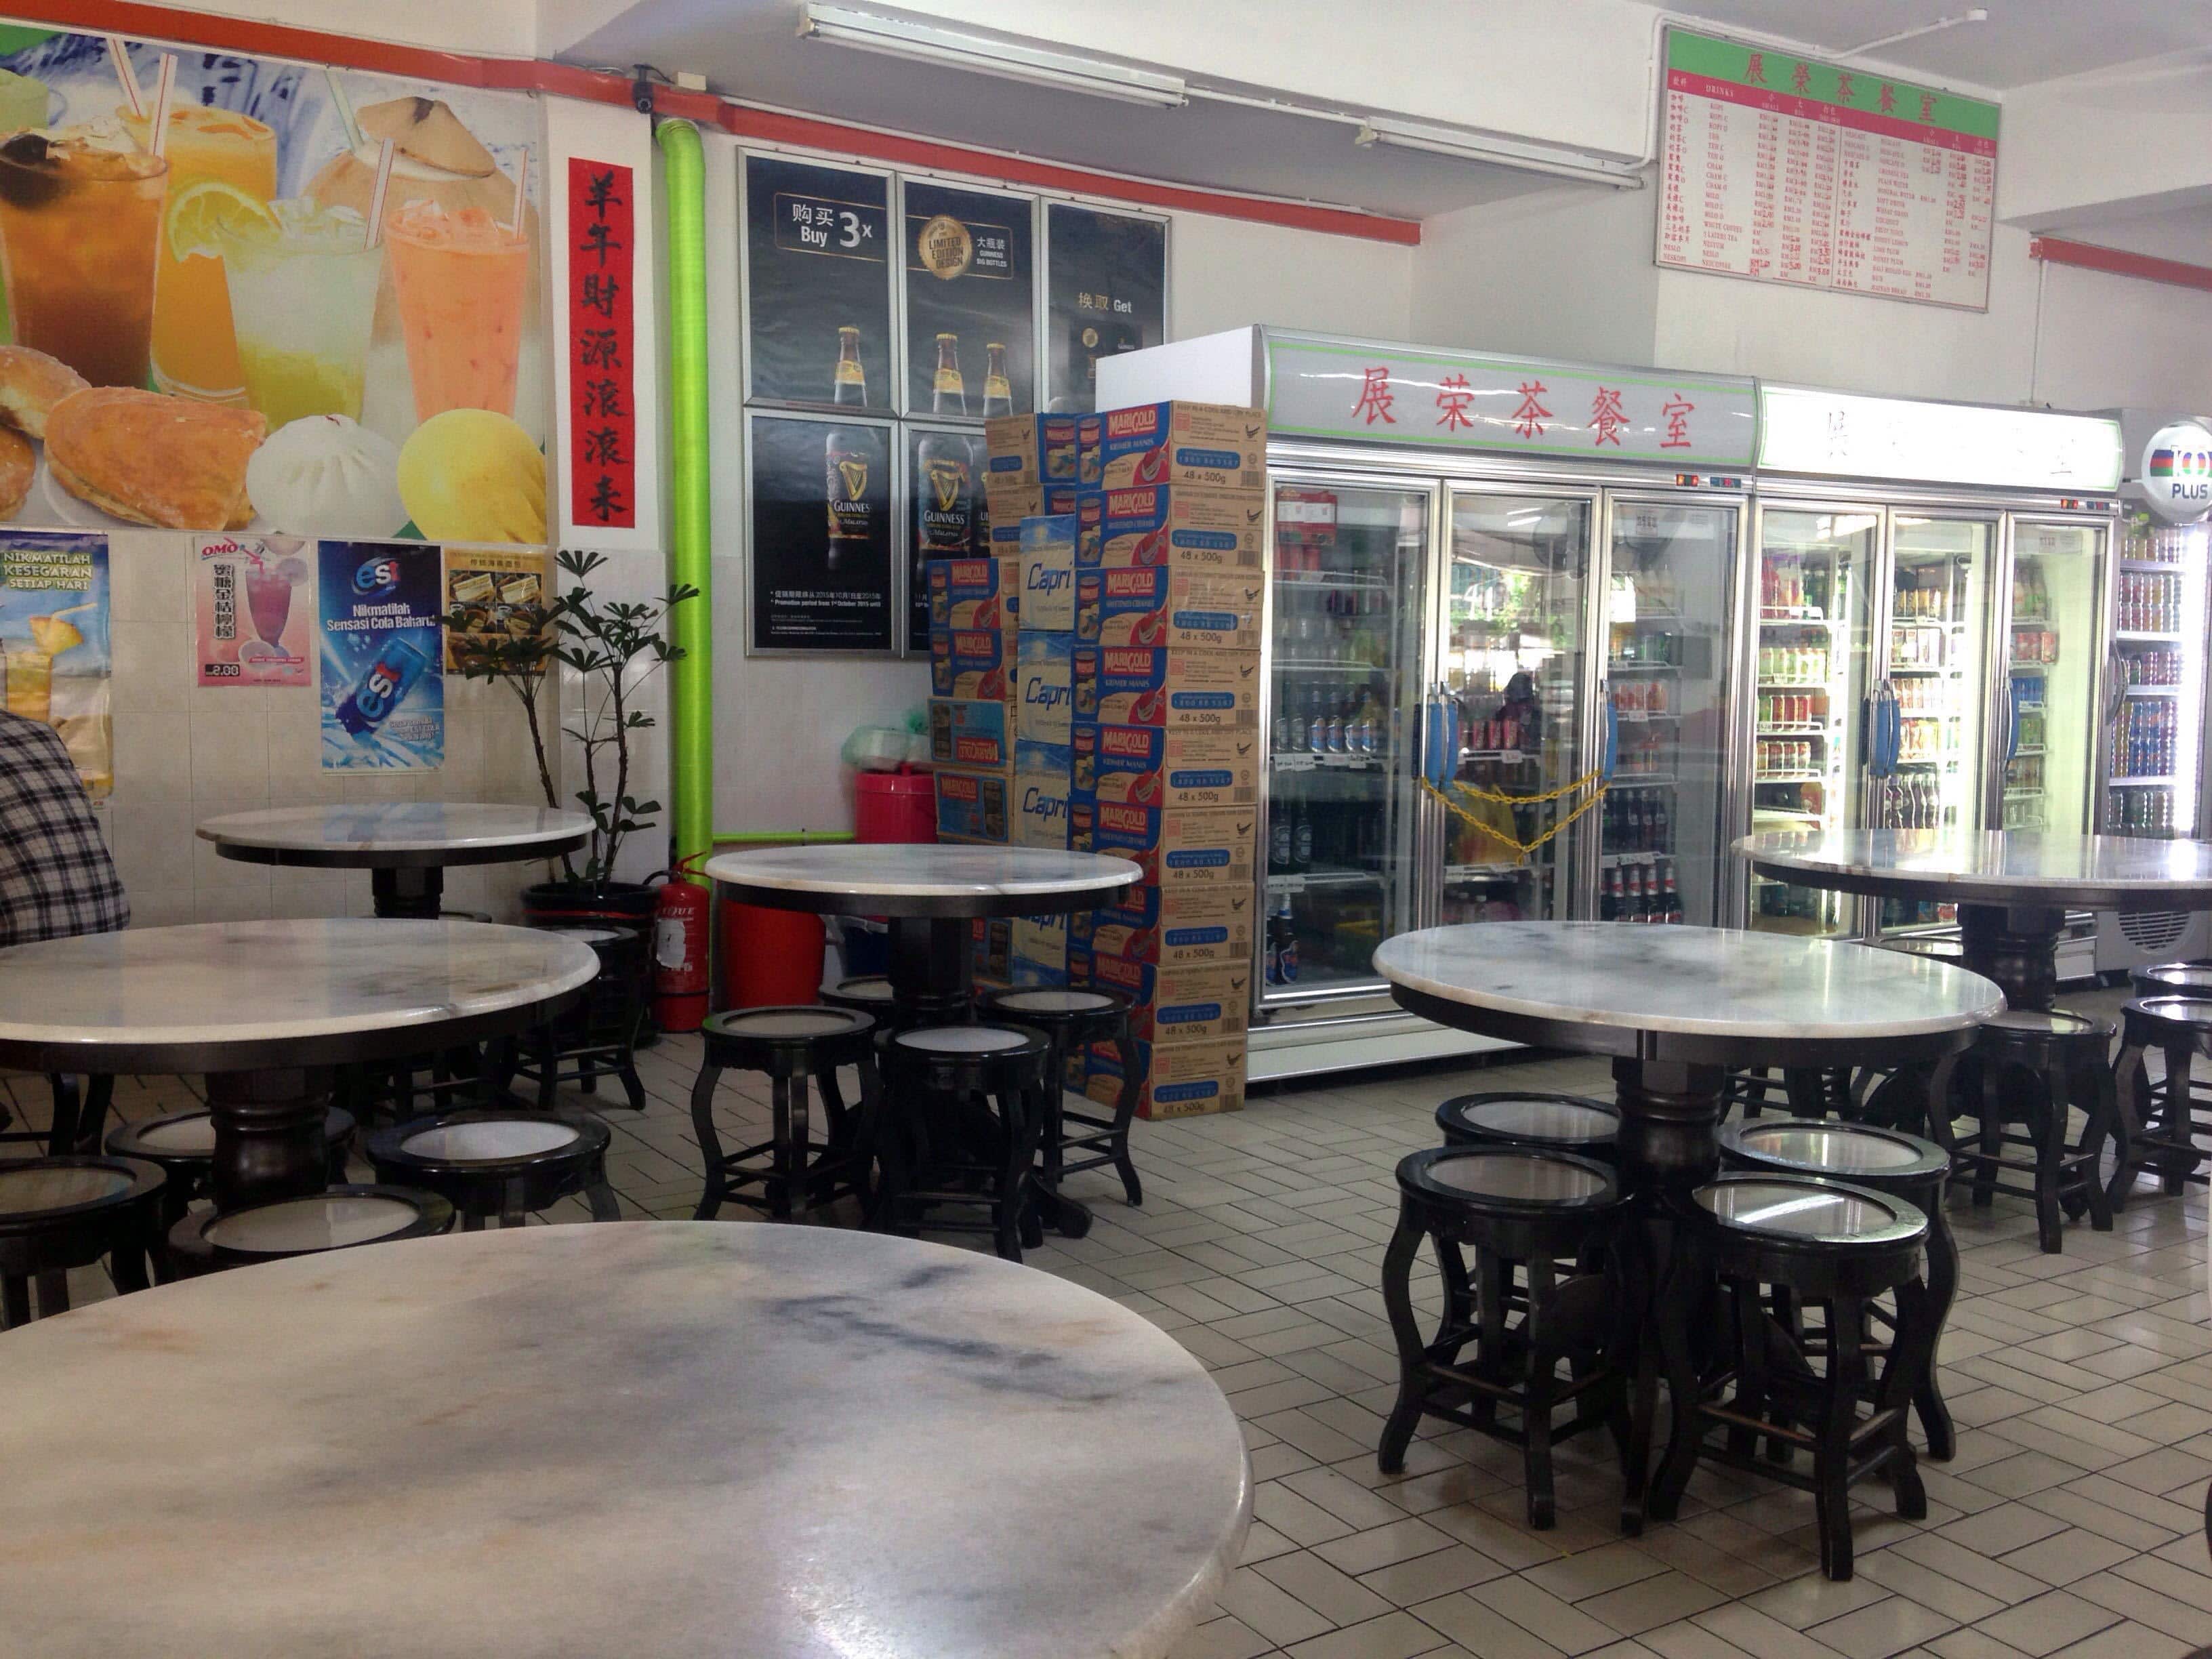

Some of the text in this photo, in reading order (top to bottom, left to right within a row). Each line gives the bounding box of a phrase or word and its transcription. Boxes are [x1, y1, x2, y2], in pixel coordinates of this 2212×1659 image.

[792, 203, 834, 226] 购买
[801, 226, 827, 247] Buy
[928, 237, 961, 249] LIMITED
[932, 247, 964, 259] EDITION
[936, 257, 963, 268] DESIGN
[1113, 300, 1132, 313] Get
[1351, 367, 1696, 448] 展荣茶餐室
[1108, 409, 1155, 436] MARIGOLD
[1184, 471, 1194, 479] 48
[2171, 483, 2208, 499] PLUS
[1109, 492, 1155, 516] MARIGOLD
[924, 510, 965, 525] GUINNESS
[202, 543, 239, 556] OMO
[1181, 552, 1191, 560] 48
[3, 552, 90, 564] NIKMATILAH
[3, 565, 92, 577] KESEGARAN
[356, 561, 401, 588] est
[1027, 560, 1073, 596] Capri
[9, 579, 87, 590] SETIAP HARI
[1107, 573, 1153, 594] MARIGOLD
[352, 602, 411, 617] Nikmatilah
[327, 617, 370, 632] Sensasi
[371, 617, 394, 630] Cola
[1181, 632, 1191, 640] 48
[1104, 651, 1151, 673] MARIGOLD
[1025, 676, 1071, 711] Capri
[1102, 731, 1149, 754] MARIGOLD
[1178, 792, 1189, 801] 48
[1023, 787, 1069, 822] Capri
[1099, 806, 1147, 832] MARIGOLD
